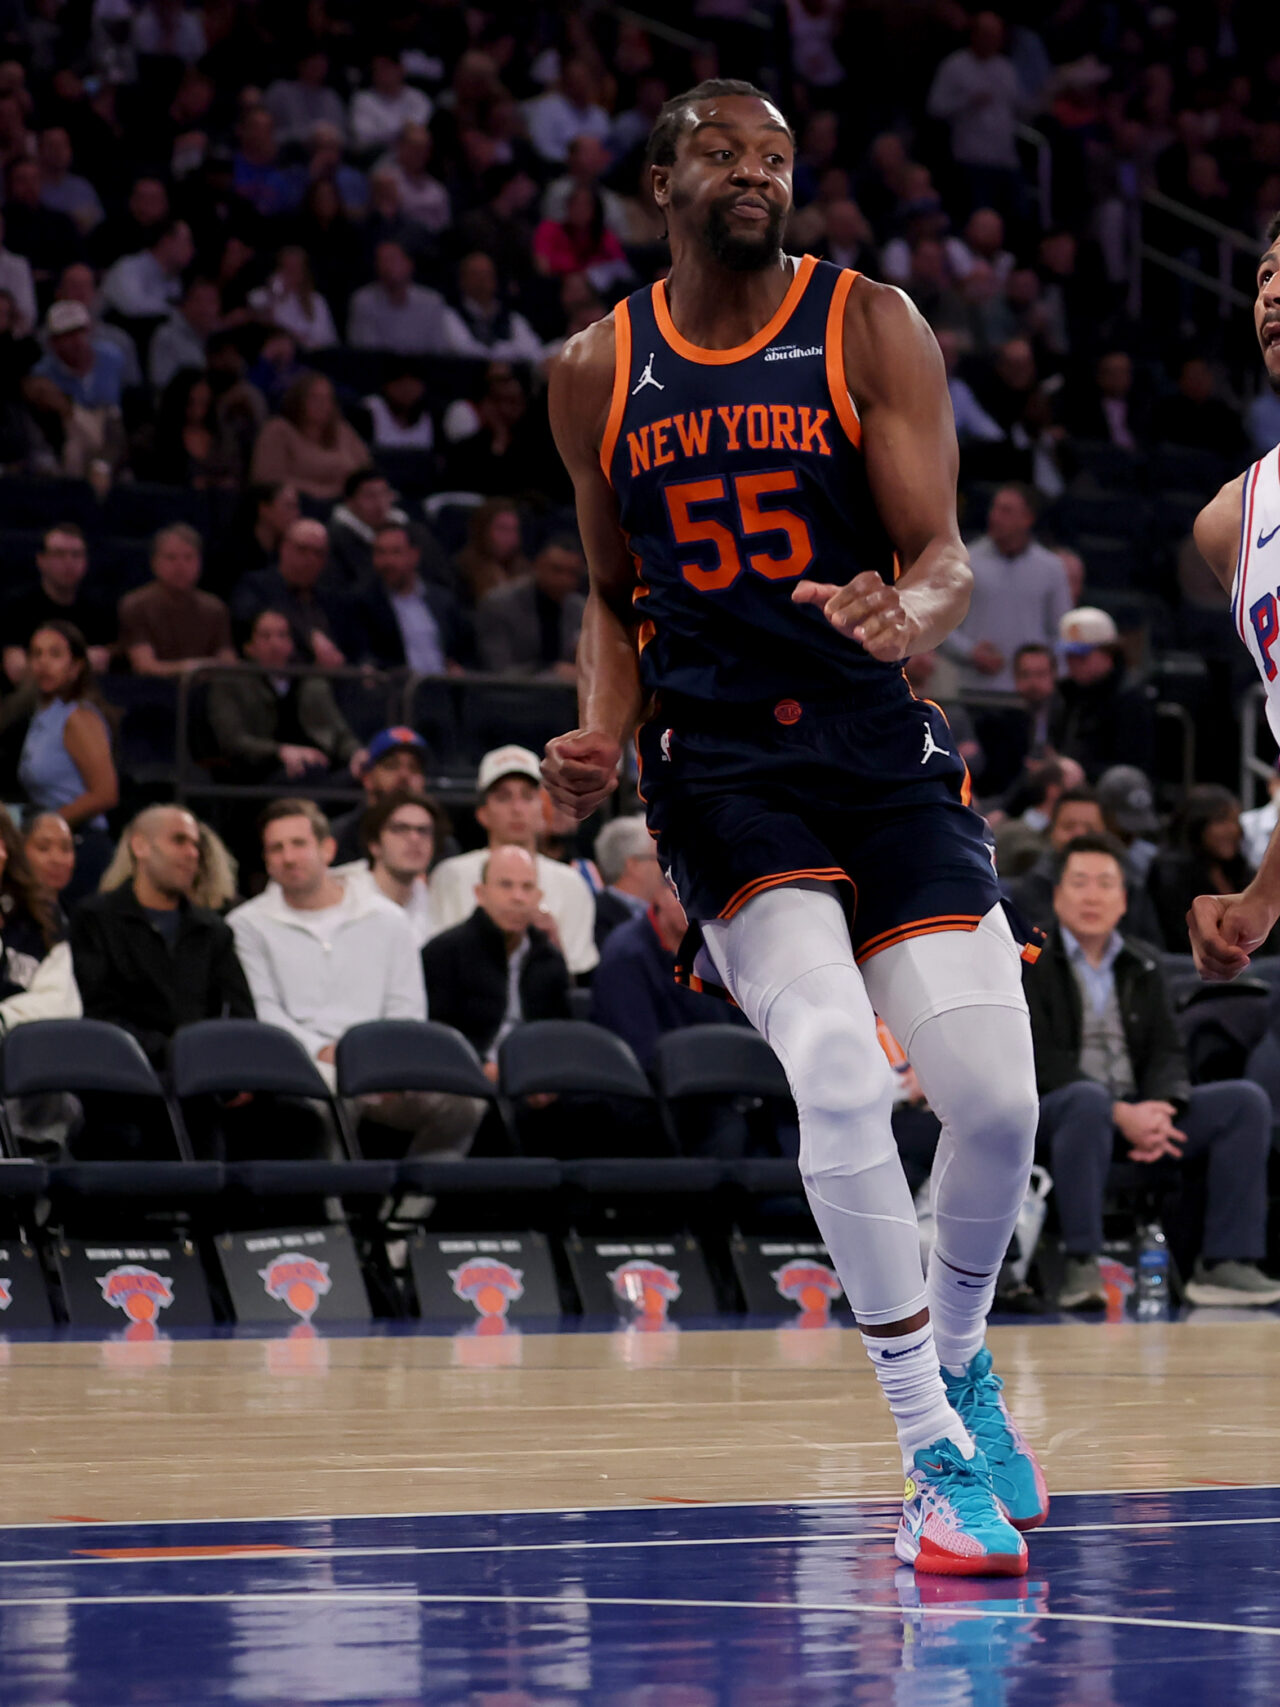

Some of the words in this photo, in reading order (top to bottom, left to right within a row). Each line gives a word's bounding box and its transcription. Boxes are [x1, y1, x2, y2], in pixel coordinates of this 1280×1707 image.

[764, 350, 787, 361] abu
[788, 346, 823, 359] dhabi
[627, 408, 712, 477] NEW
[717, 404, 832, 456] YORK
[663, 470, 814, 592] 55
